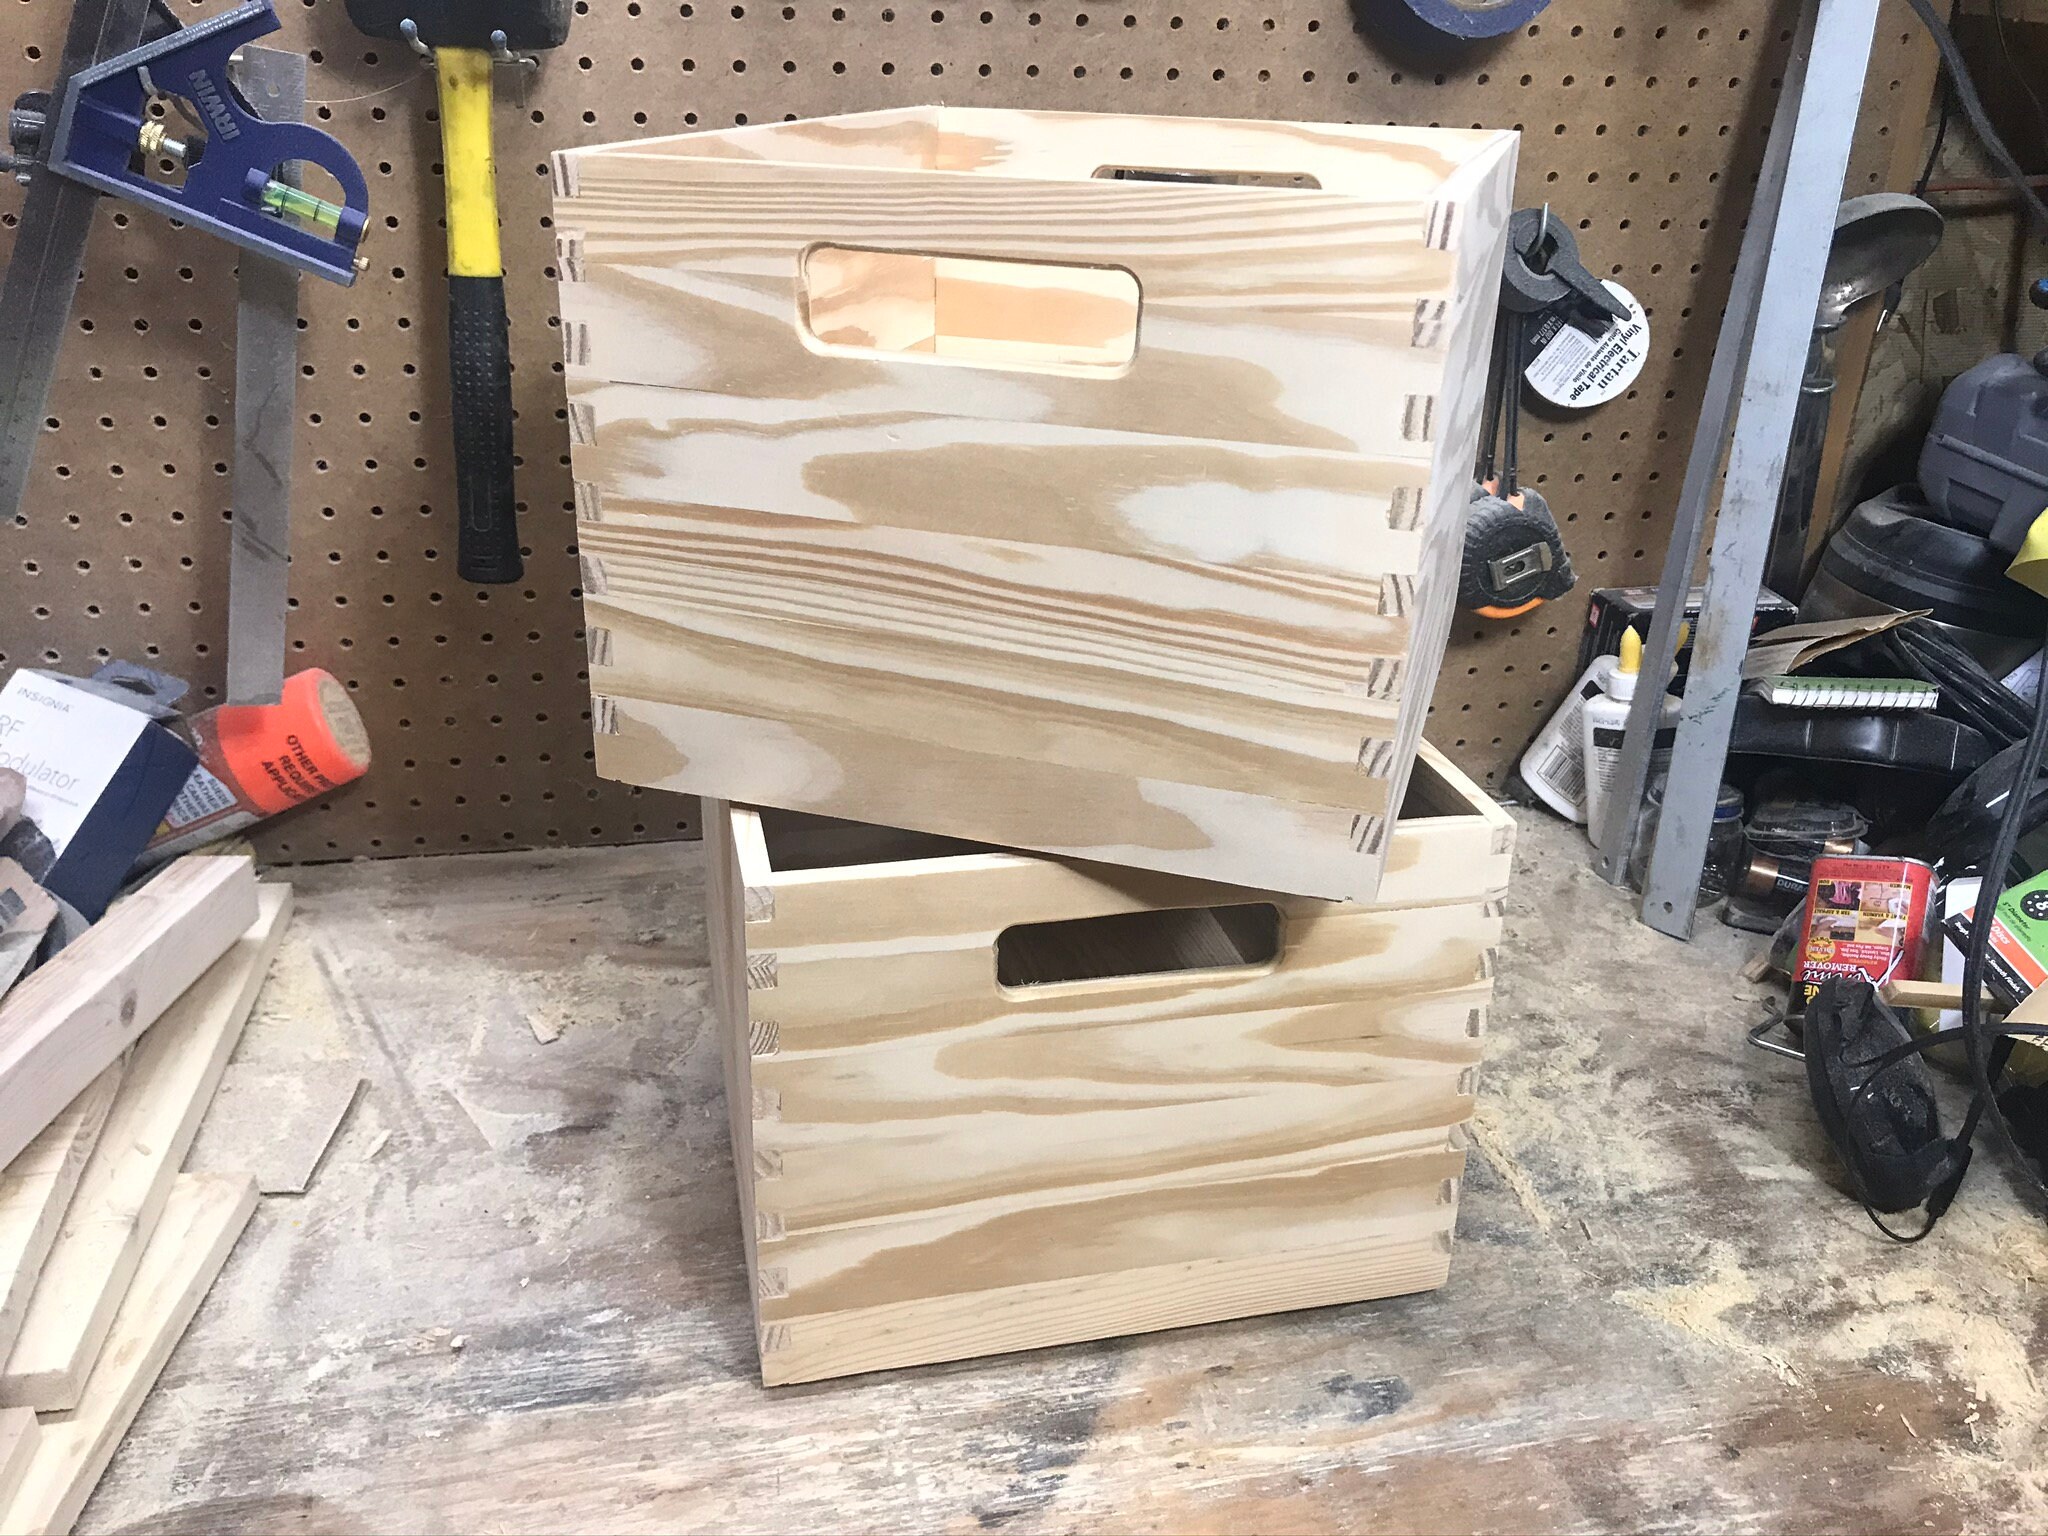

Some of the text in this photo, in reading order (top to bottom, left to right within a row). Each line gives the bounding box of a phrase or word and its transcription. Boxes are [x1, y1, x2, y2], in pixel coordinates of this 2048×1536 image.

[188, 69, 240, 141] IRWIN
[1569, 323, 1641, 401] Vinyl Electrical Tape
[1572, 328, 1621, 383] Cinta Aislante de Vinilo
[1597, 349, 1640, 389] Tartan
[17, 688, 70, 712] INSIGNIA
[0, 752, 80, 790] odulator
[287, 734, 318, 775] OTHER
[193, 773, 219, 809] EATHER
[1954, 922, 1969, 936] Tough
[1991, 926, 2010, 944] Discs
[2008, 907, 2030, 930] Diameter
[1804, 961, 1857, 972] REMOVER
